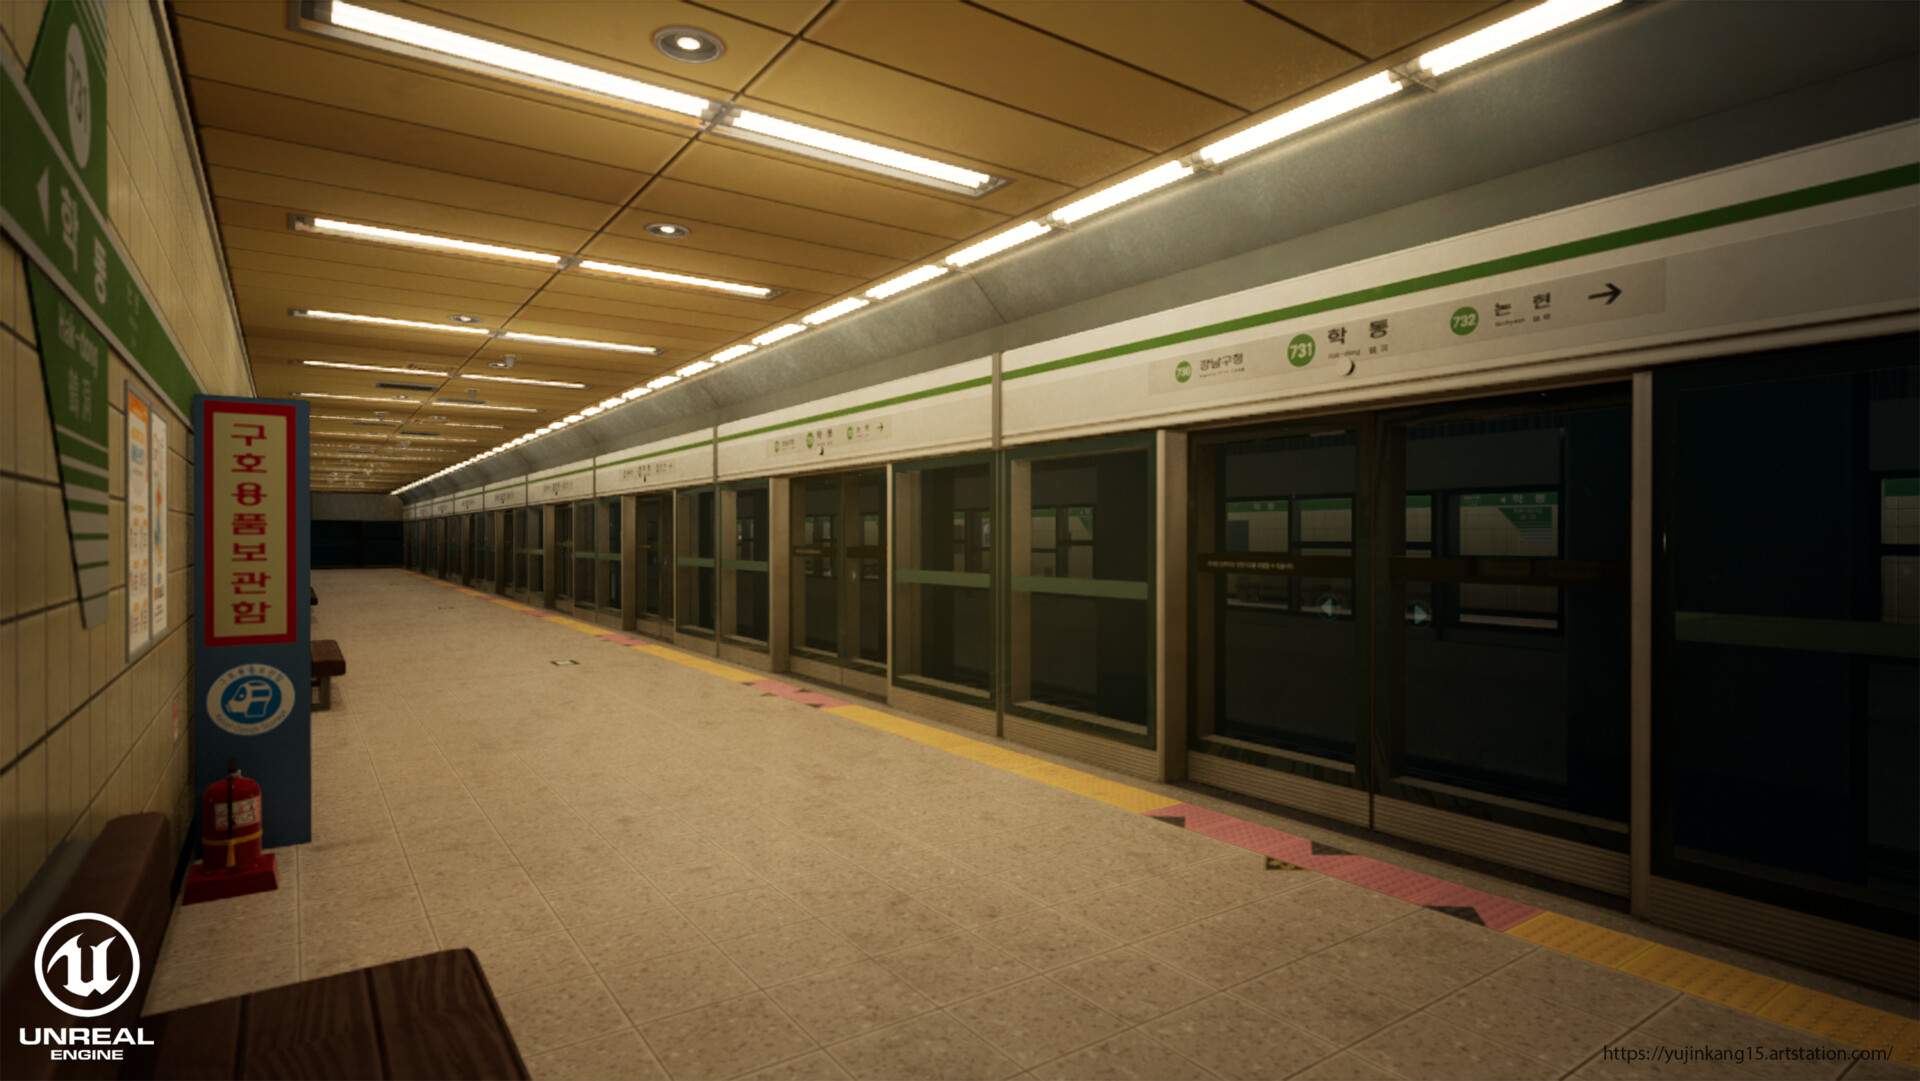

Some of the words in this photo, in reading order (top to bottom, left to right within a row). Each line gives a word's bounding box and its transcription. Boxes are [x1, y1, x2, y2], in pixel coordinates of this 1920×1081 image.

[68, 53, 88, 135] 731
[1452, 313, 1477, 329] 732
[1289, 341, 1314, 361] 731
[231, 423, 272, 625] 구호용품보관함
